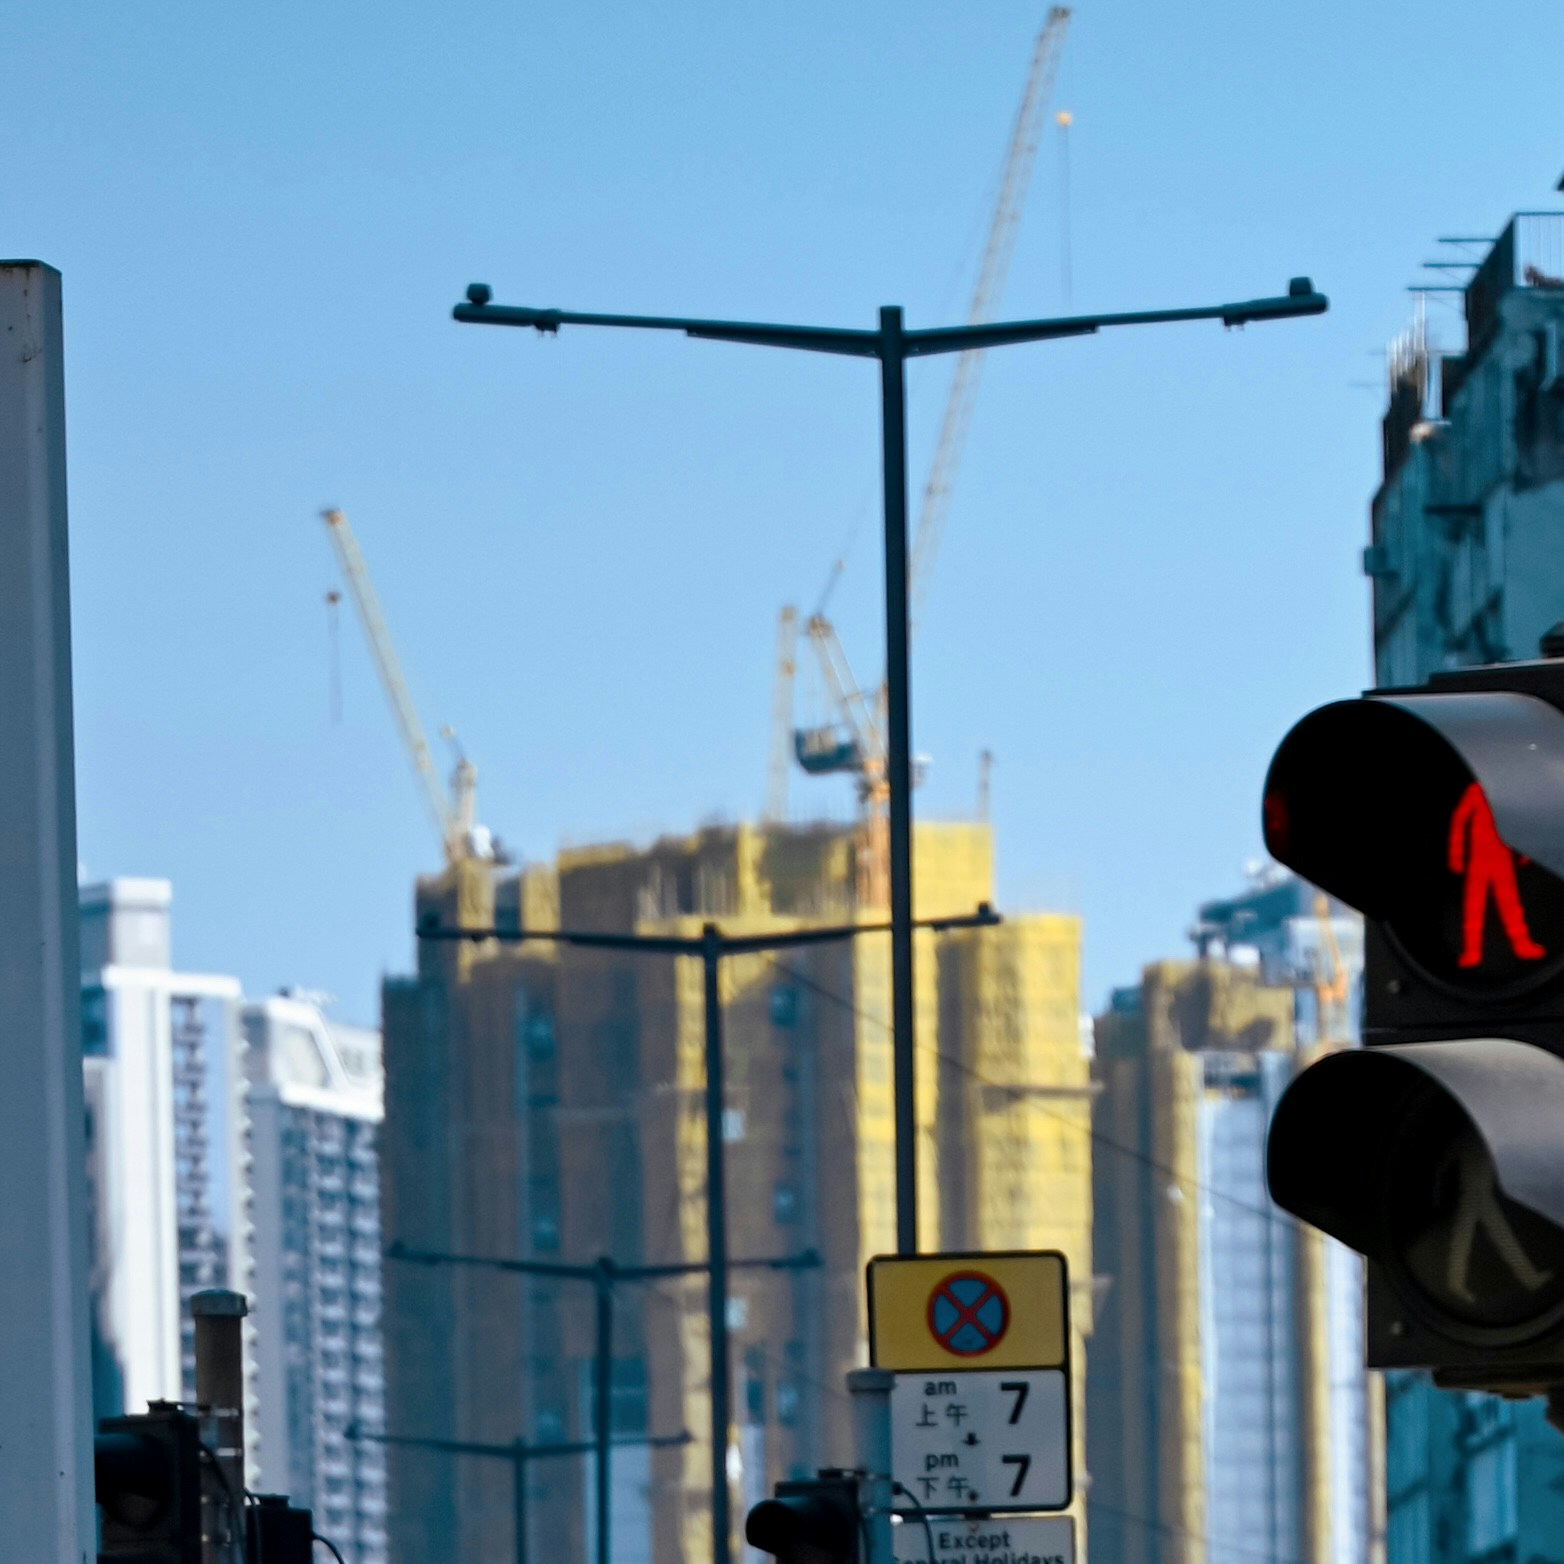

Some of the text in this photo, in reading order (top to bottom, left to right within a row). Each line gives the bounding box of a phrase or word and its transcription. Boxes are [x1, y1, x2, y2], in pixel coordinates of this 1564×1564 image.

[915, 1403, 968, 1427] 上午
[924, 1381, 1029, 1425] am 7
[917, 1476, 968, 1499] 下午
[925, 1454, 1031, 1497] pm 7
[939, 1530, 1010, 1551] Except
